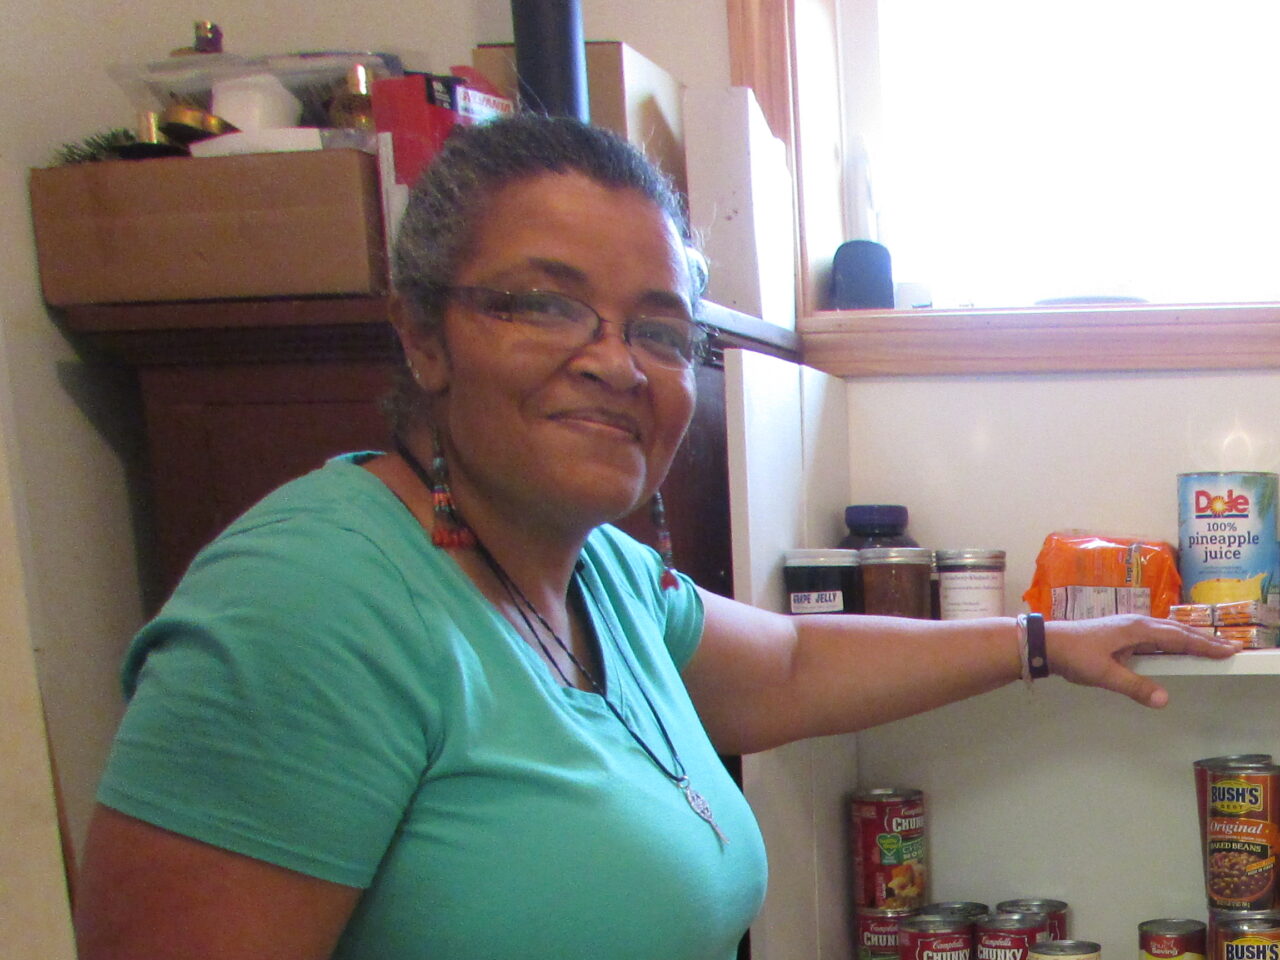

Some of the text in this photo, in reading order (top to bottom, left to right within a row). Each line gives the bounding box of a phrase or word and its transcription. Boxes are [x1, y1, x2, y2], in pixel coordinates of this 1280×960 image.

[1195, 489, 1249, 515] Dole
[1207, 522, 1237, 531] 100%
[1188, 531, 1259, 548] pineapple
[1203, 547, 1241, 563] juice
[816, 592, 837, 603] JELLY
[1211, 785, 1259, 805] BUSH'S
[1211, 822, 1264, 835] Original
[1232, 842, 1261, 852] BEANS
[1226, 944, 1279, 960] BUSH'S
